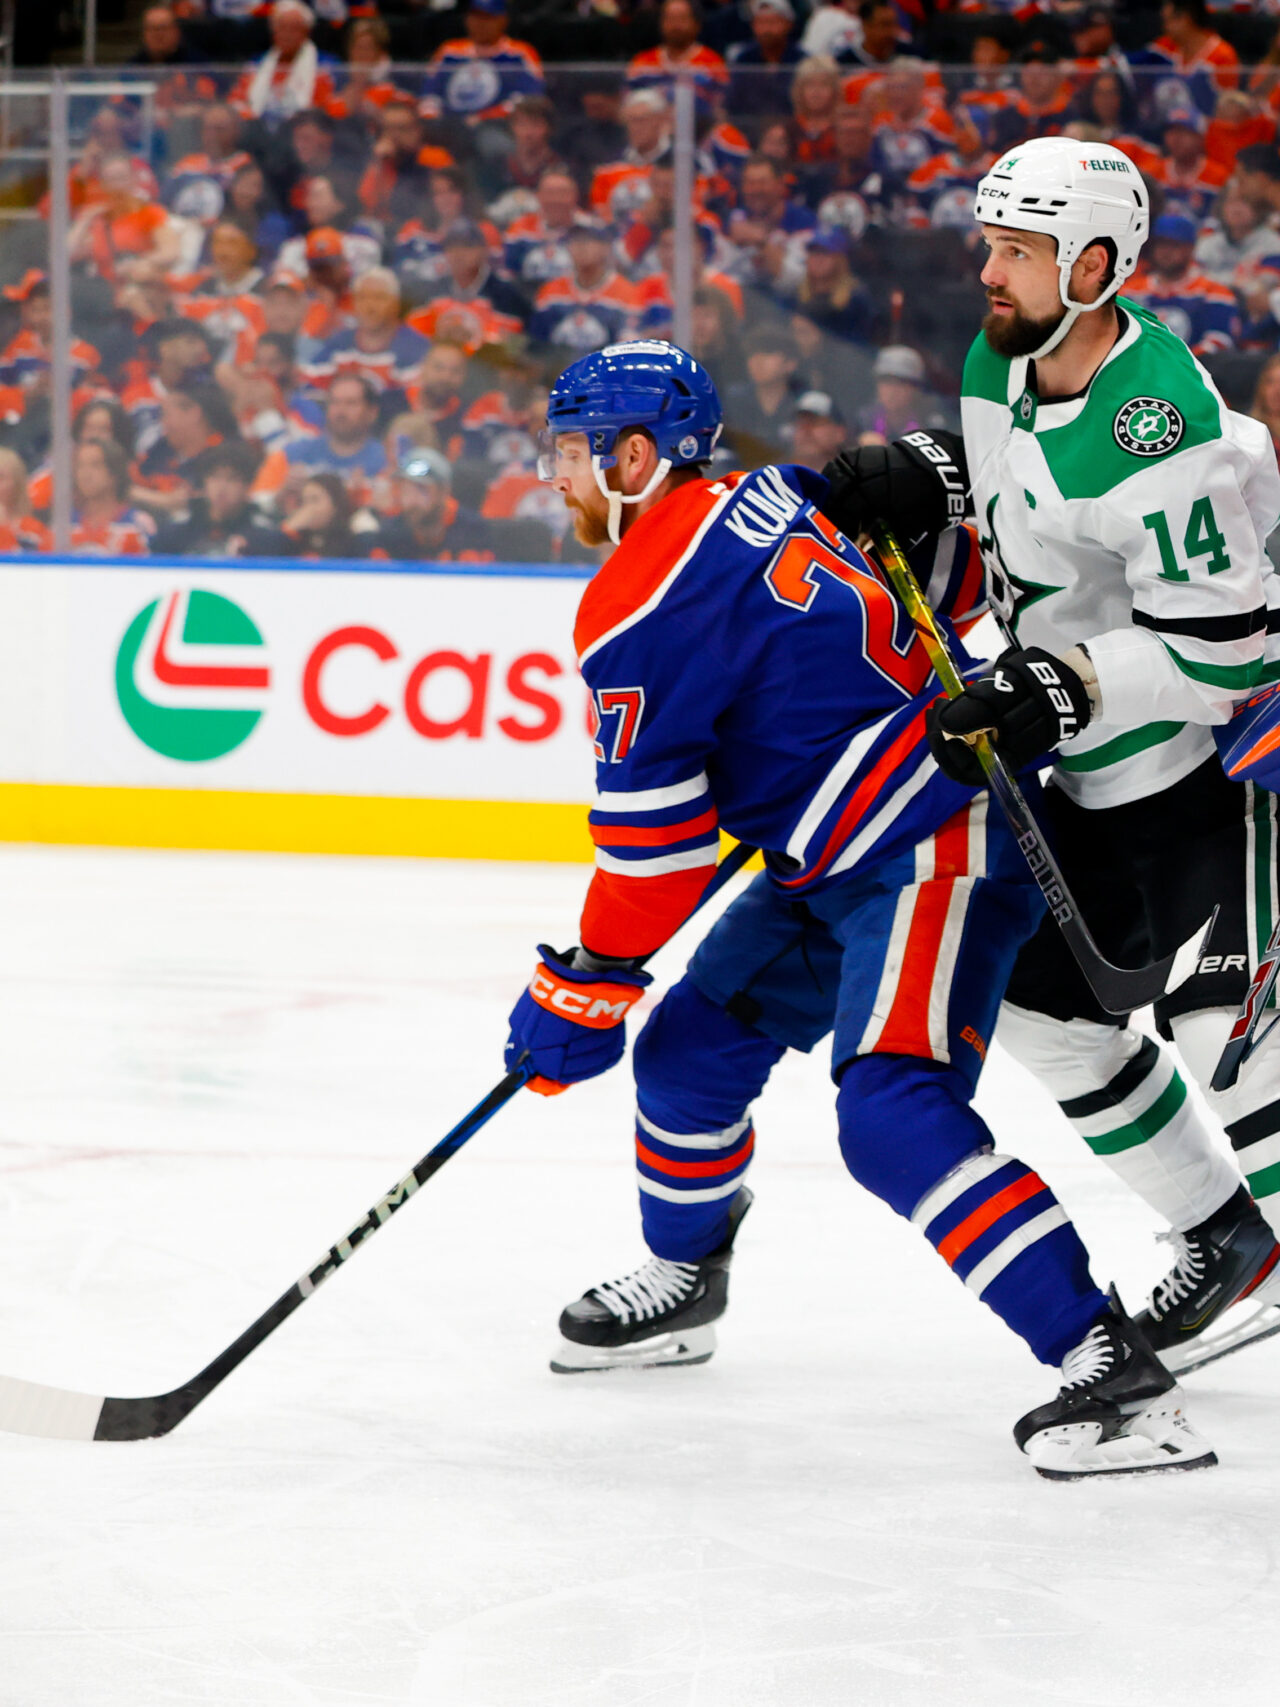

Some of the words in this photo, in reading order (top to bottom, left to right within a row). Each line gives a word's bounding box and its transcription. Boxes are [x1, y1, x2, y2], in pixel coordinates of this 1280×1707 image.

[1079, 159, 1130, 174] 7-ELEVEN
[981, 187, 1010, 200] CCM
[1118, 400, 1172, 434] DALLAS
[1130, 423, 1180, 452] STARS
[1142, 495, 1232, 582] 14
[300, 624, 602, 743] Cas
[529, 972, 630, 1020] CCM
[297, 1169, 421, 1300] CCM
